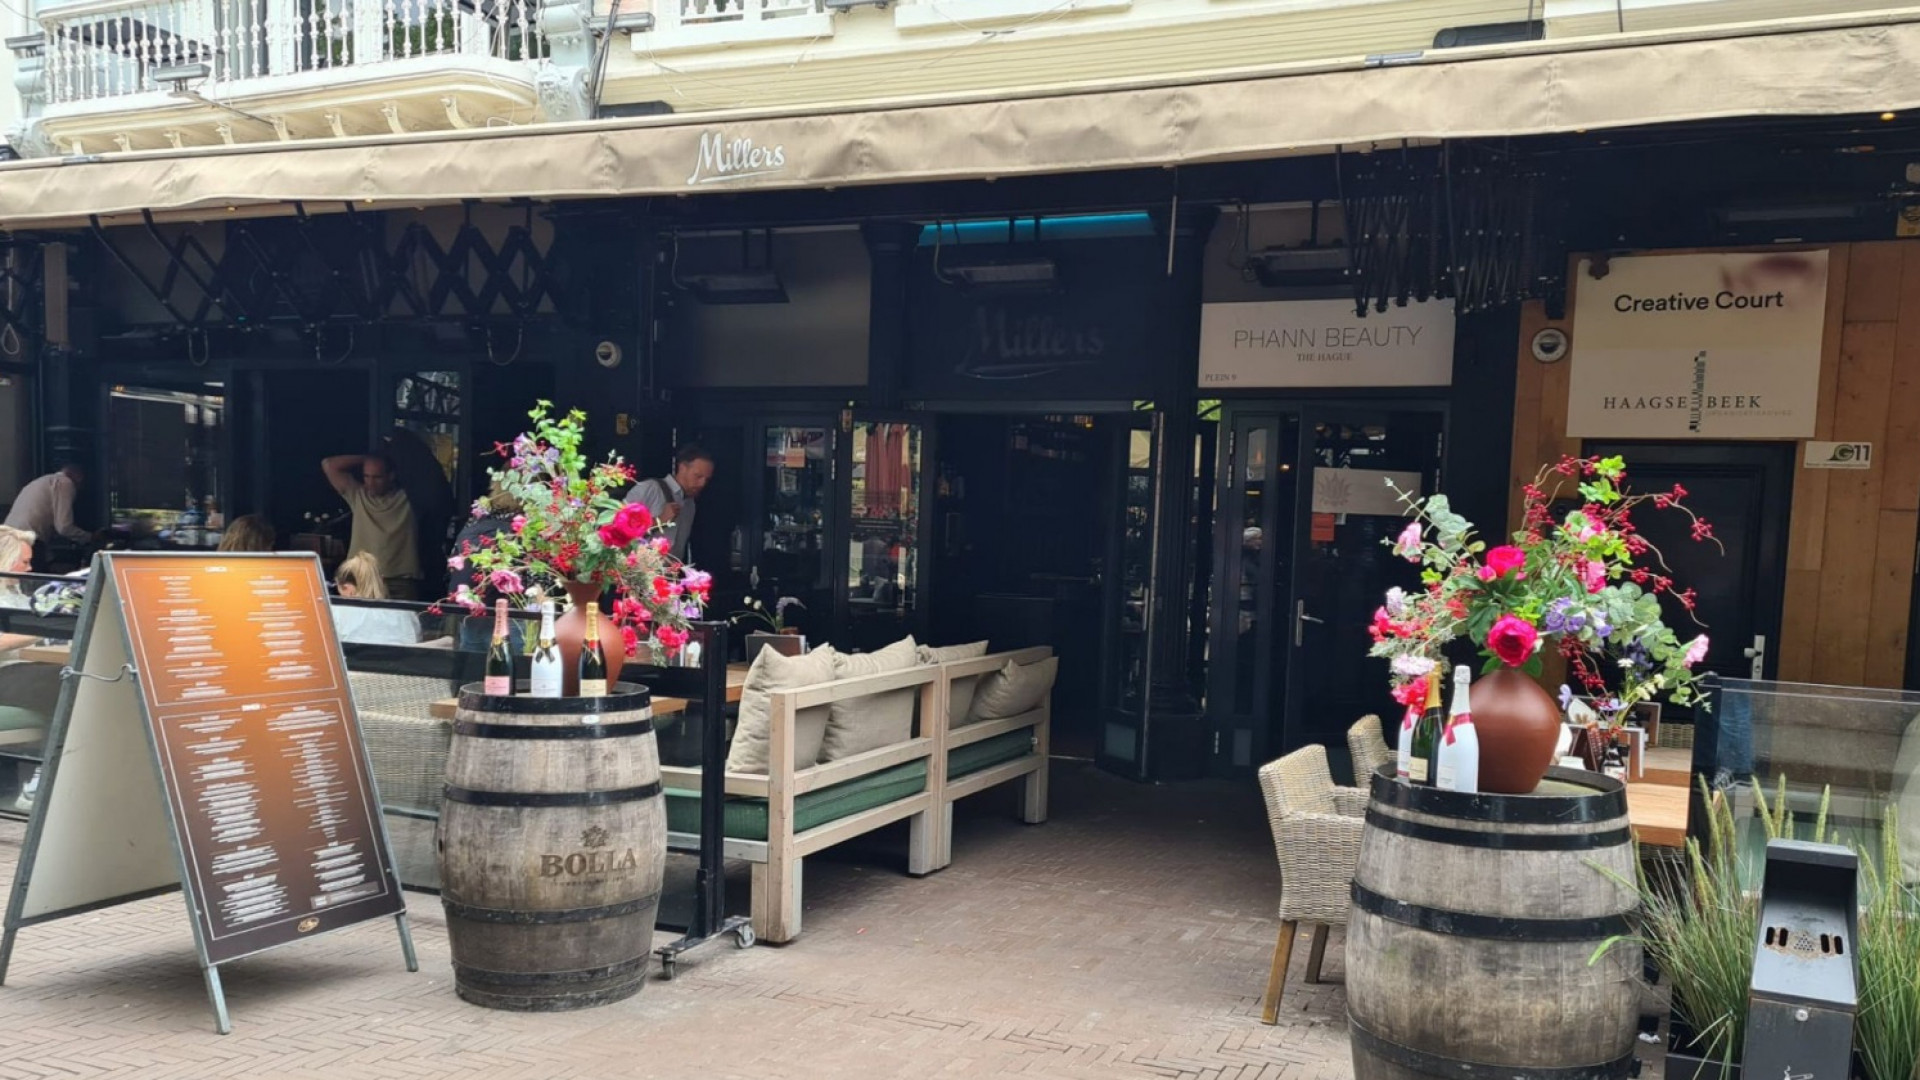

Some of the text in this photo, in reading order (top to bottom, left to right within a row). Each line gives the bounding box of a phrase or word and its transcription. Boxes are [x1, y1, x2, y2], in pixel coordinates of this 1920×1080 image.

[687, 132, 785, 185] Millers
[1614, 291, 1784, 312] Creative Court
[953, 306, 1105, 374] Millers
[1234, 326, 1423, 348] PHANN BEAUTY
[1297, 352, 1352, 361] THE HAGUE
[1603, 395, 1762, 410] HAAGSE BEEK
[540, 848, 636, 877] BOLLA
